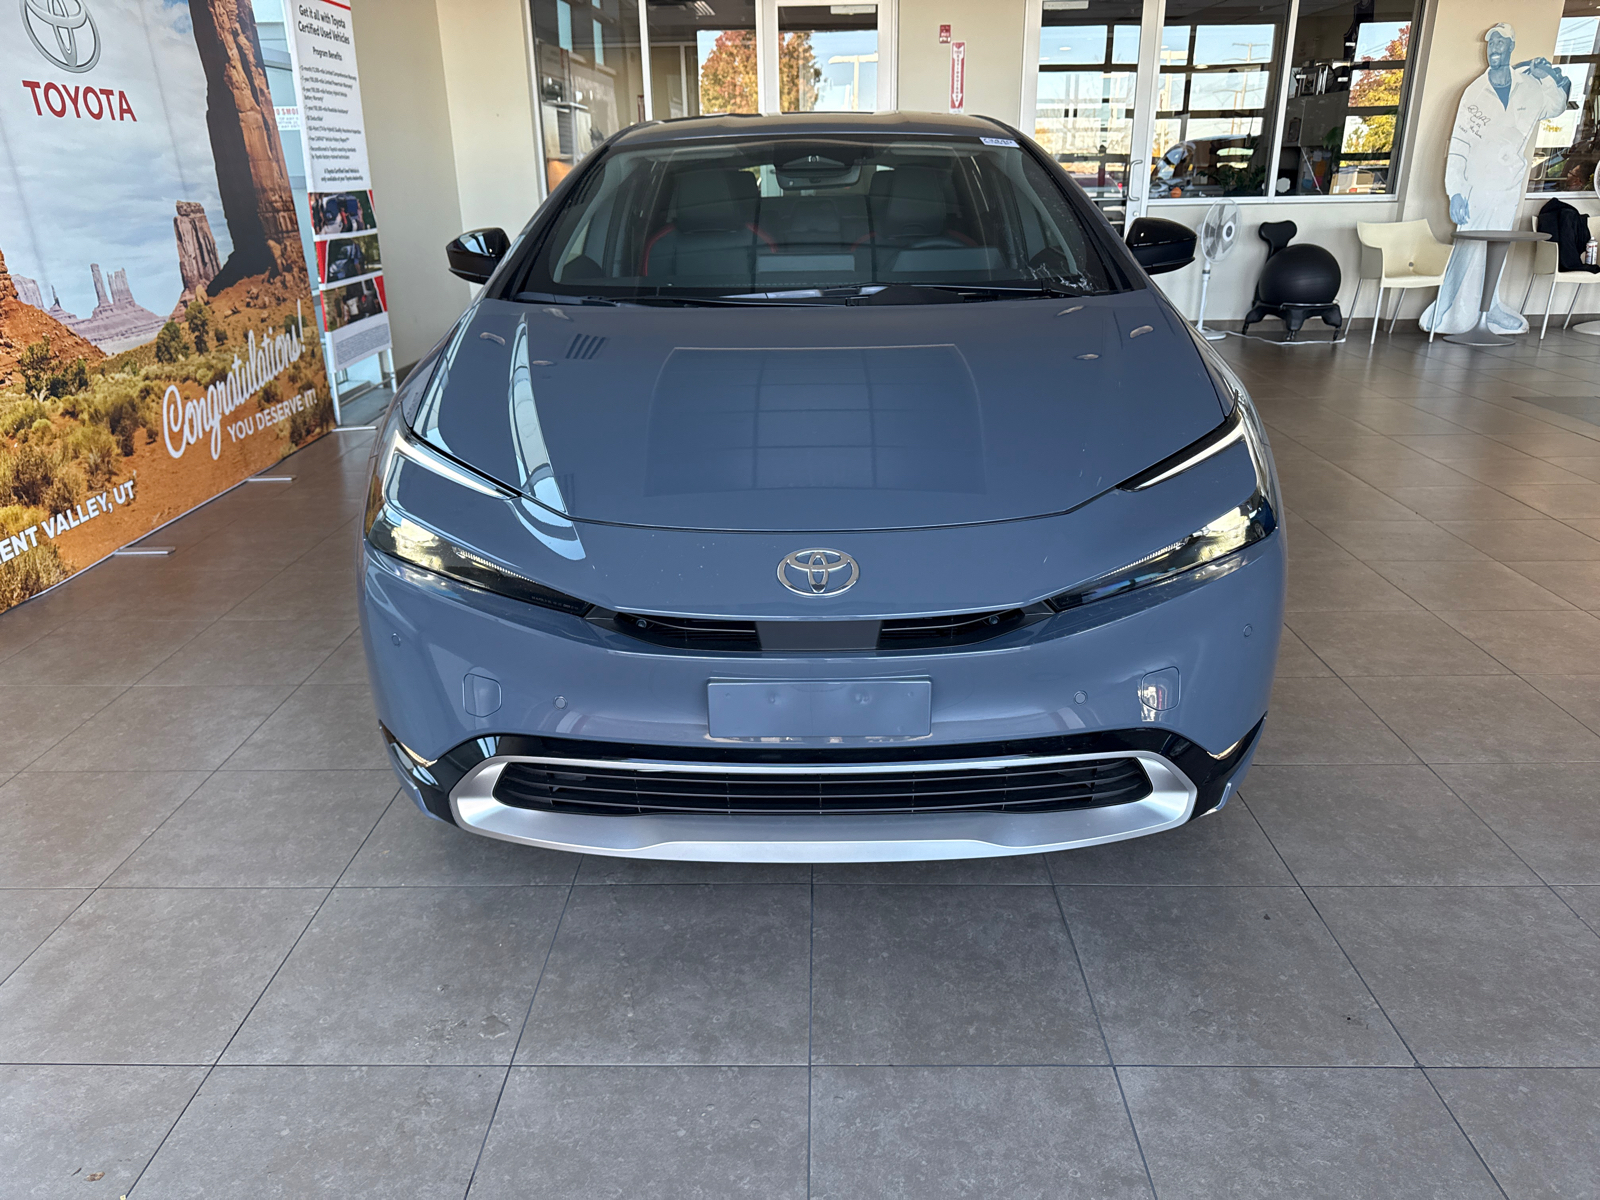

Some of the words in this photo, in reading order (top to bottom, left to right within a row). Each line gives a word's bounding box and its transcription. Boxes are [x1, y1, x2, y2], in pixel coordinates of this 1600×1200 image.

[298, 20, 320, 36] Certified
[320, 26, 332, 39] Used
[332, 30, 350, 44] Vehicles
[299, 4, 309, 17] Get
[320, 12, 331, 24] with
[331, 14, 346, 29] Toyota
[312, 46, 328, 58] Program
[22, 79, 137, 122] TOYOTA
[162, 298, 306, 460] Congratulations!
[227, 416, 255, 443] YOU
[255, 395, 305, 428] DESERVE
[304, 388, 318, 410] IT!
[0, 525, 38, 564] ENT
[41, 491, 114, 539] VALLEY,
[112, 479, 135, 505] UT
